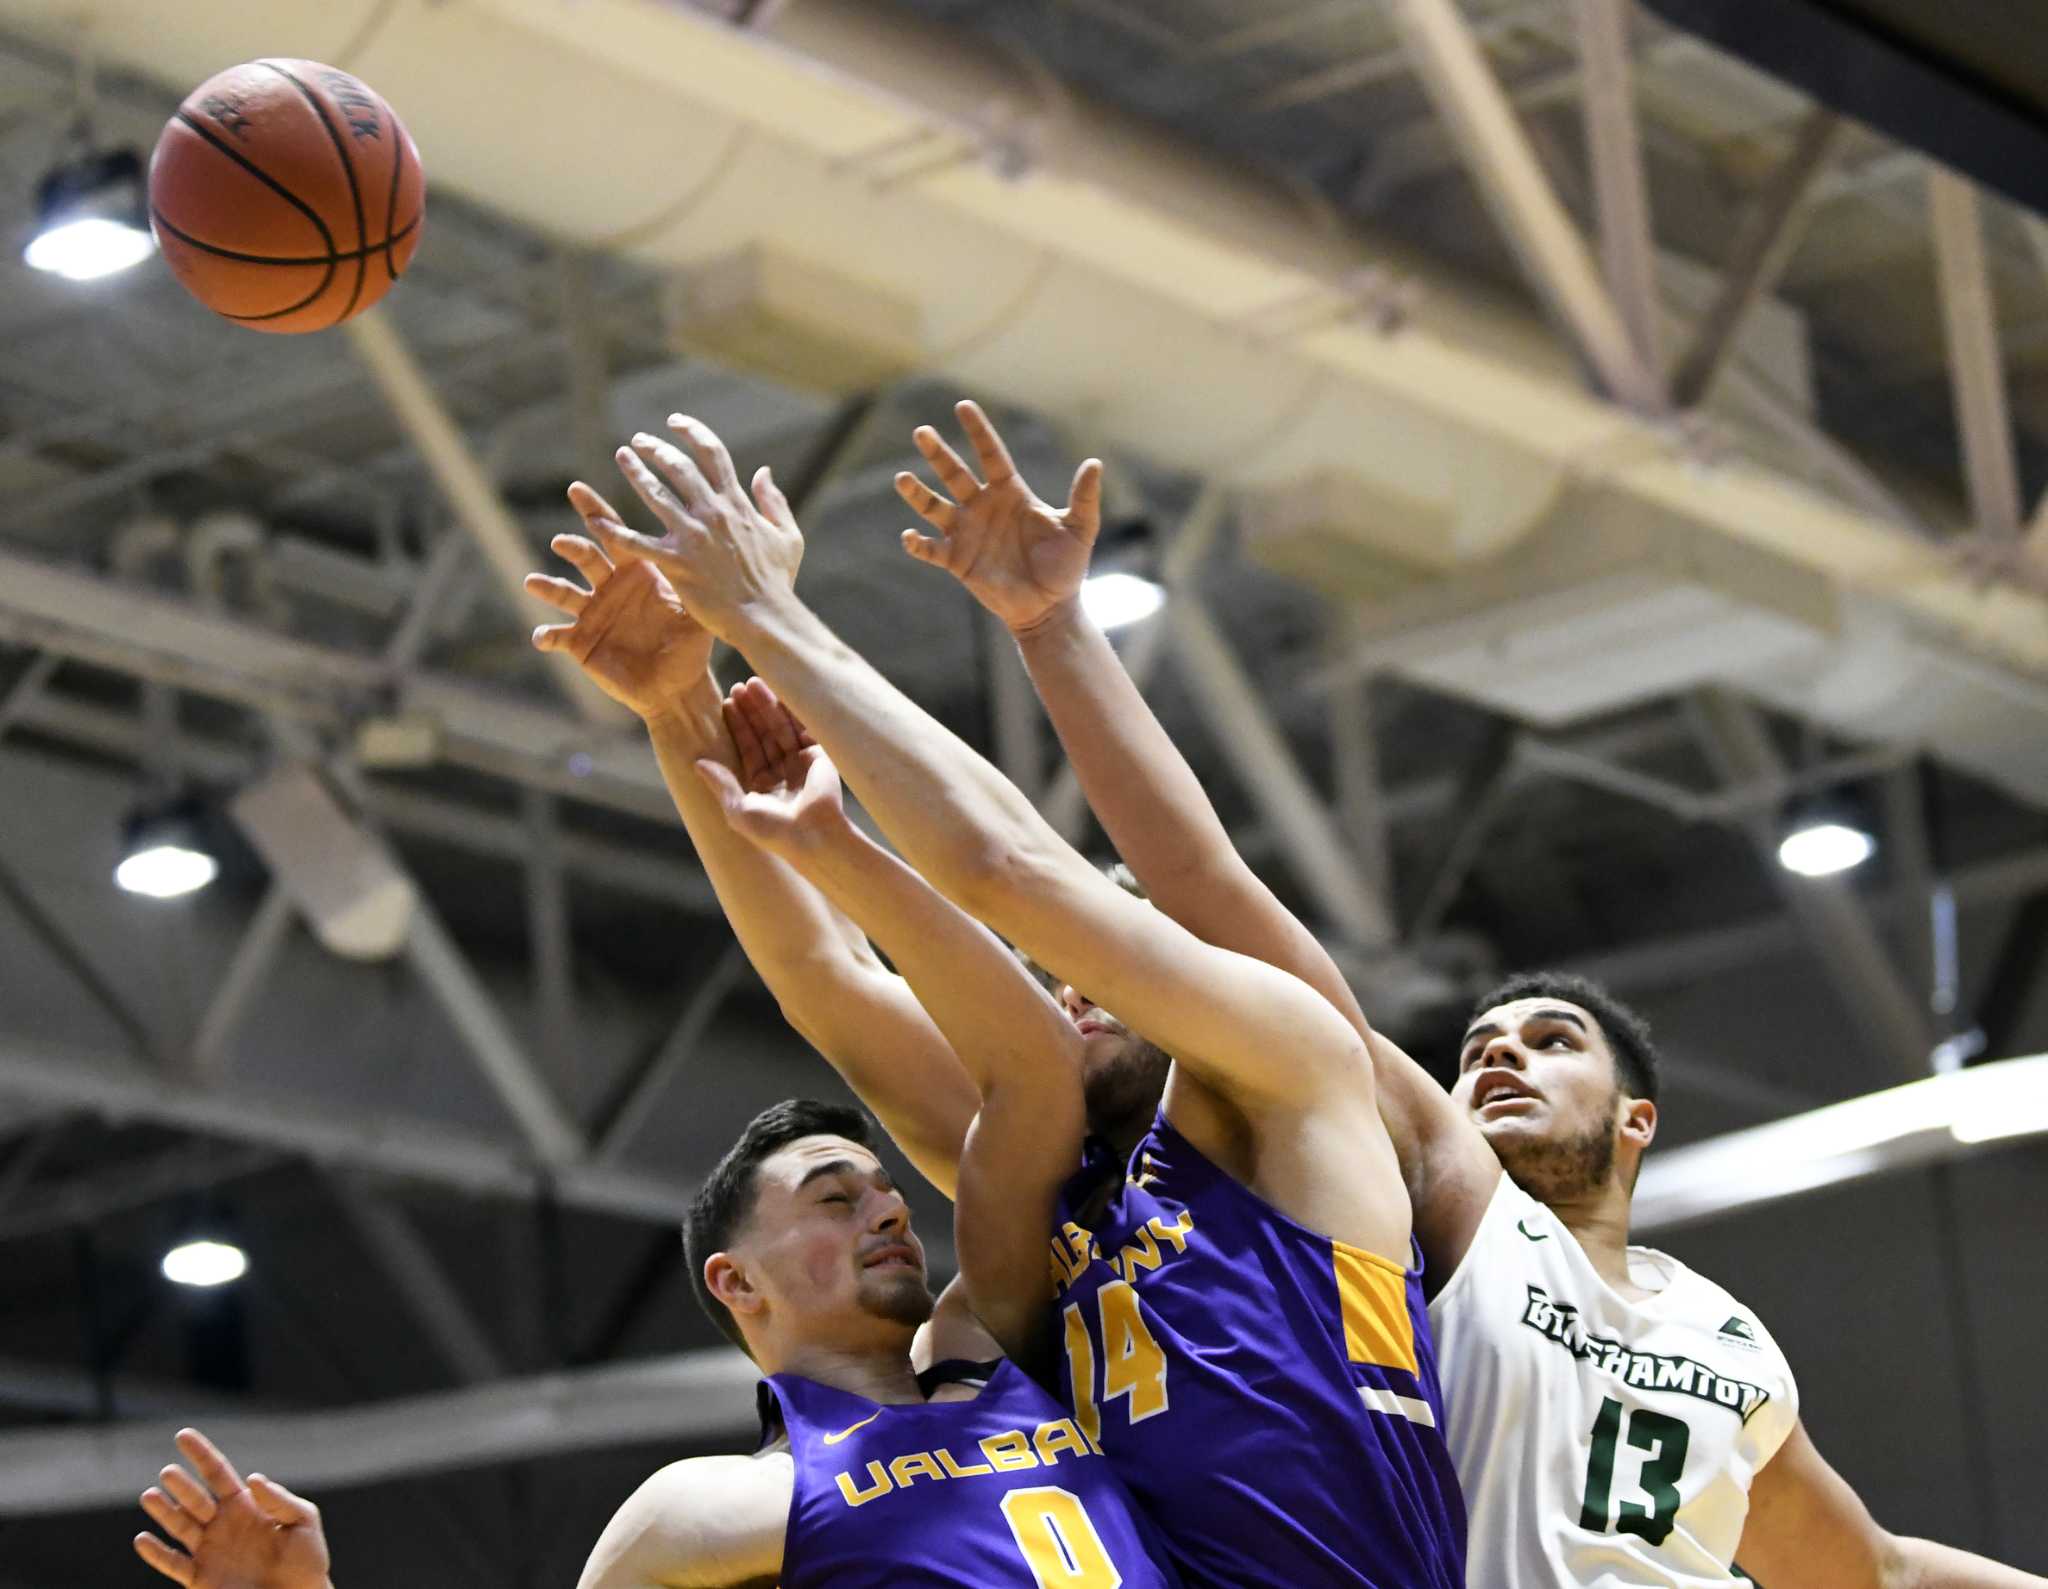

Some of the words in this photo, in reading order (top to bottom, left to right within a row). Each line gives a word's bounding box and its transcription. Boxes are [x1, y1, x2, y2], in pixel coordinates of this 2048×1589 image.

[1063, 1279, 1169, 1442] 14
[1000, 1485, 1123, 1589] 0
[1580, 1396, 1690, 1547] 13
